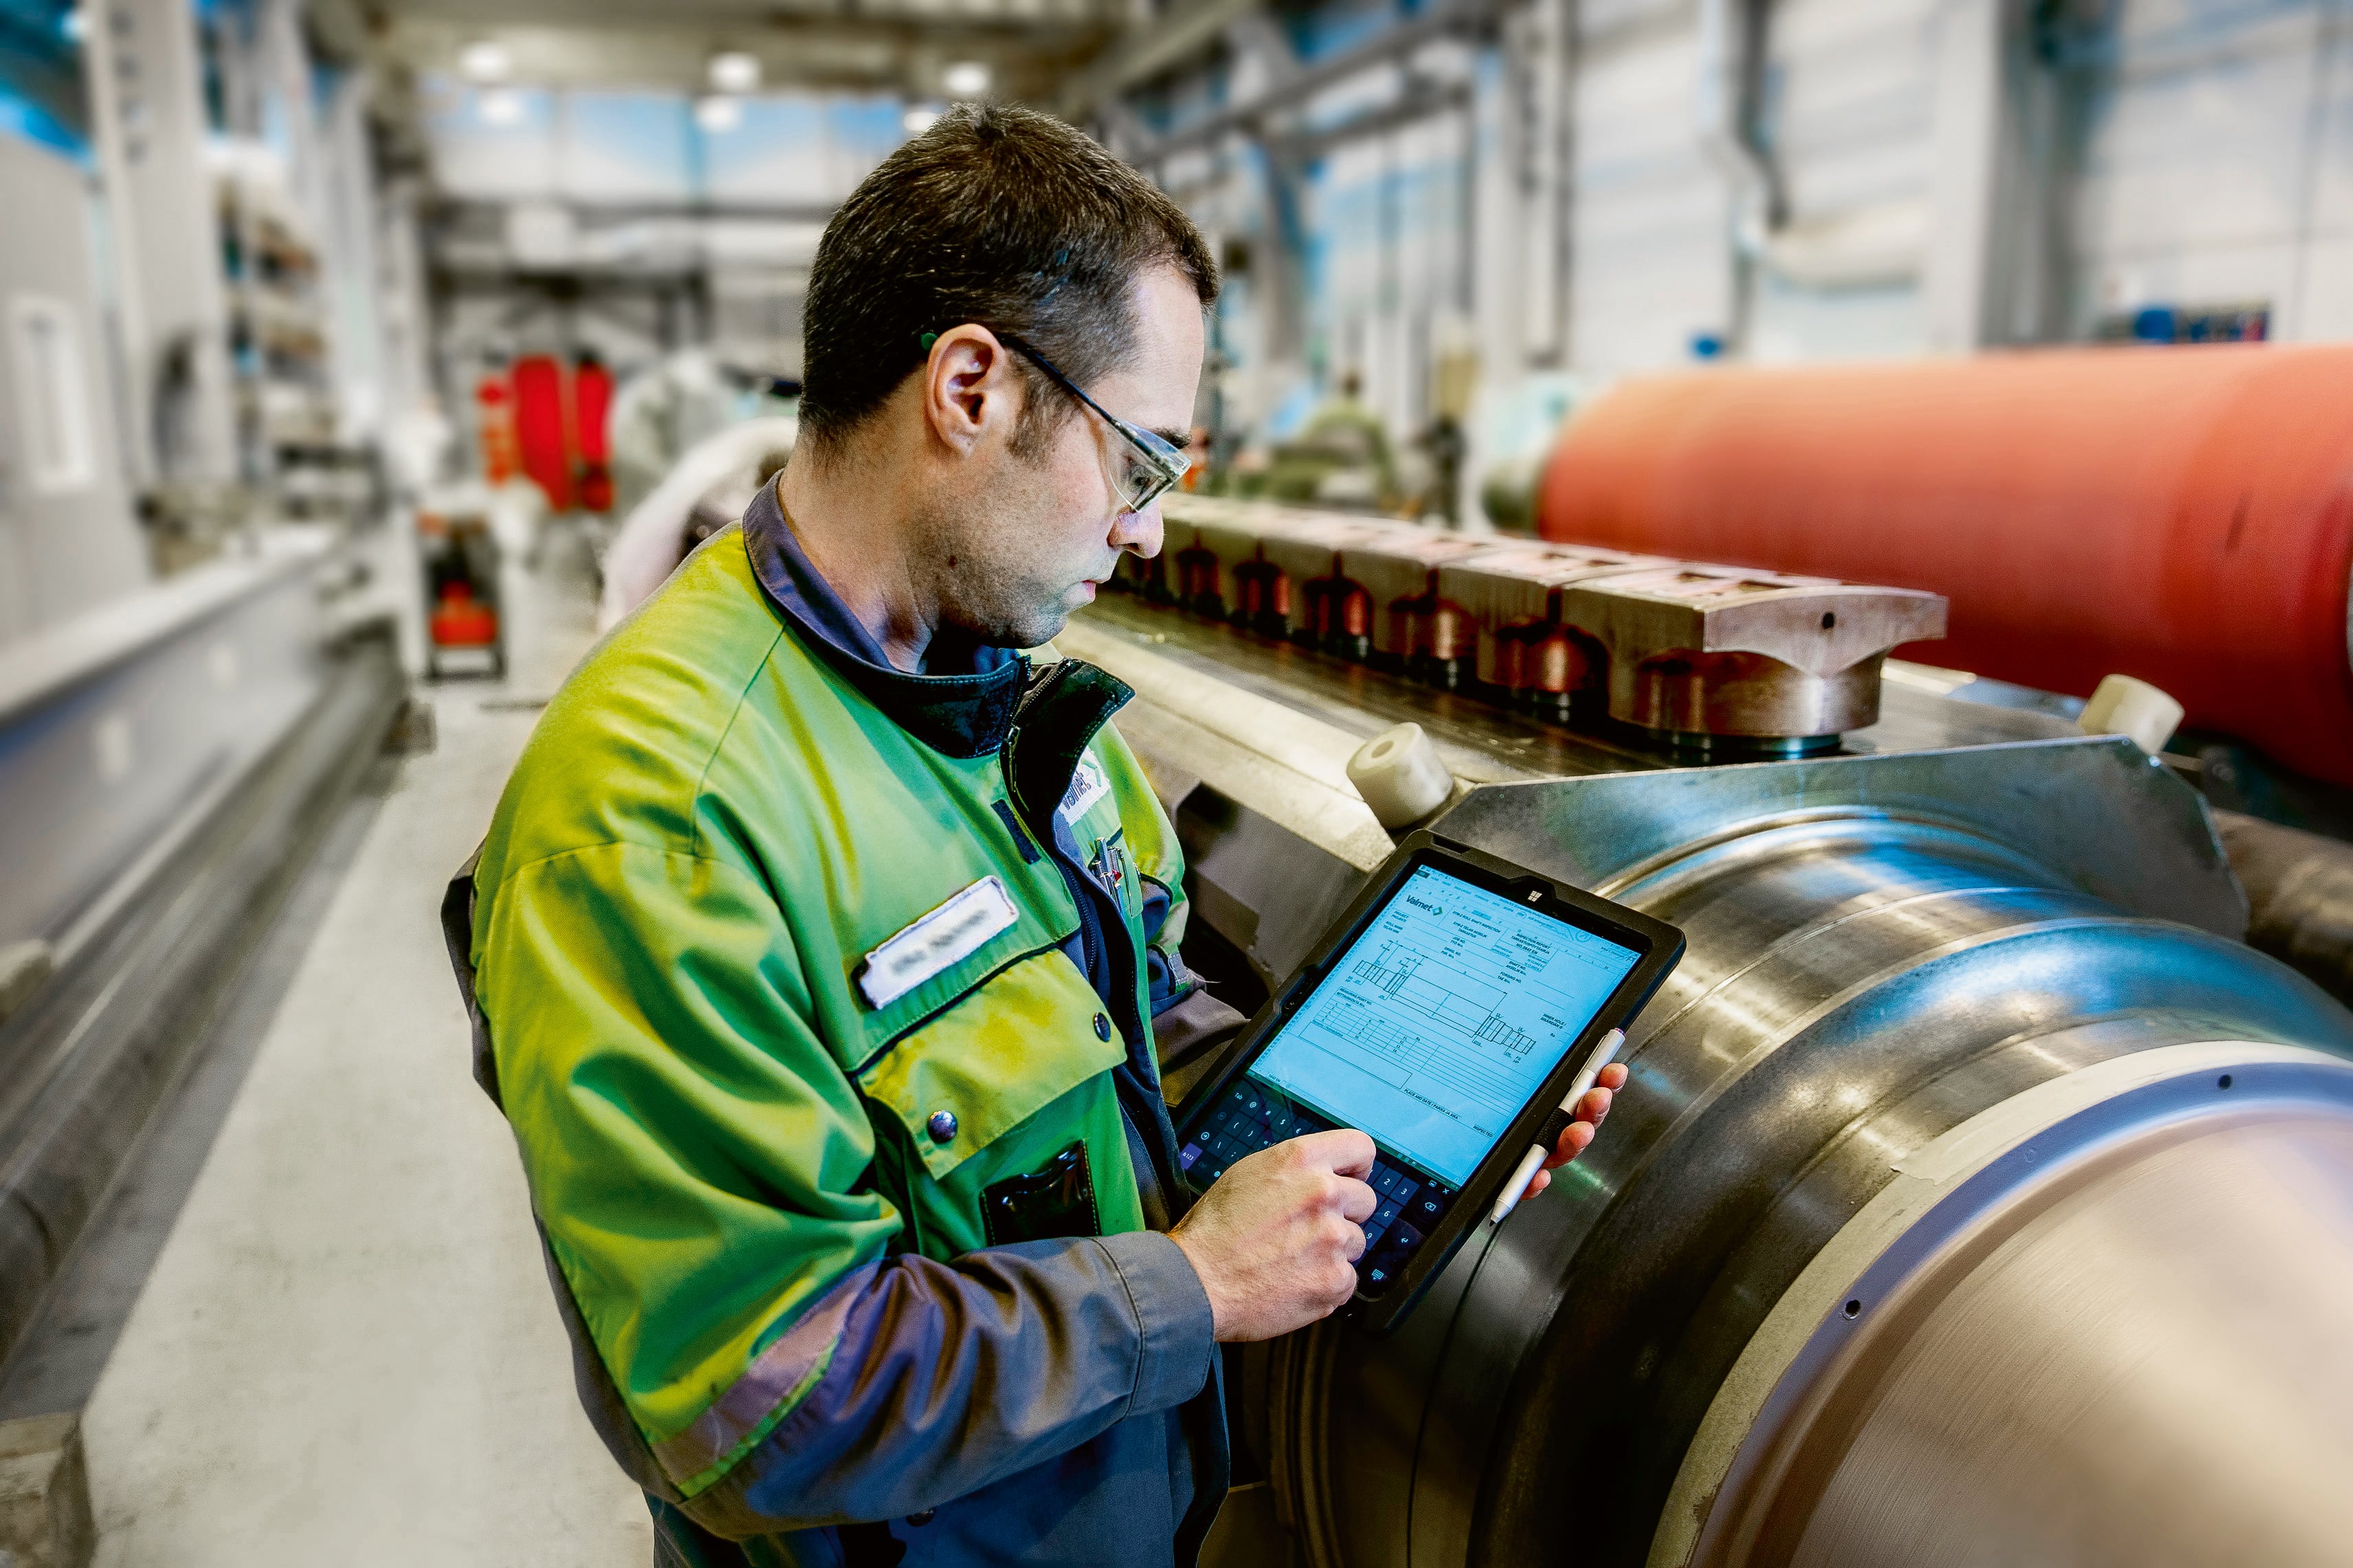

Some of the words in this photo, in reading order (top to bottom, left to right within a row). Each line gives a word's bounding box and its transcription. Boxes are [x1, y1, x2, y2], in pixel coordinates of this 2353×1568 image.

[1406, 895, 1433, 912] Valmet
[1458, 928, 1476, 938] TARKASTUS
[1481, 923, 1500, 933] INSPECTION
[1516, 933, 1535, 943] INSPECTION
[1500, 972, 1515, 980] FORGING
[1340, 988, 1357, 997] MEASURING
[1433, 1104, 1445, 1112] PAIKKA
[1472, 1126, 1492, 1137] INSPECTED
[1182, 1152, 1194, 1161] &123
